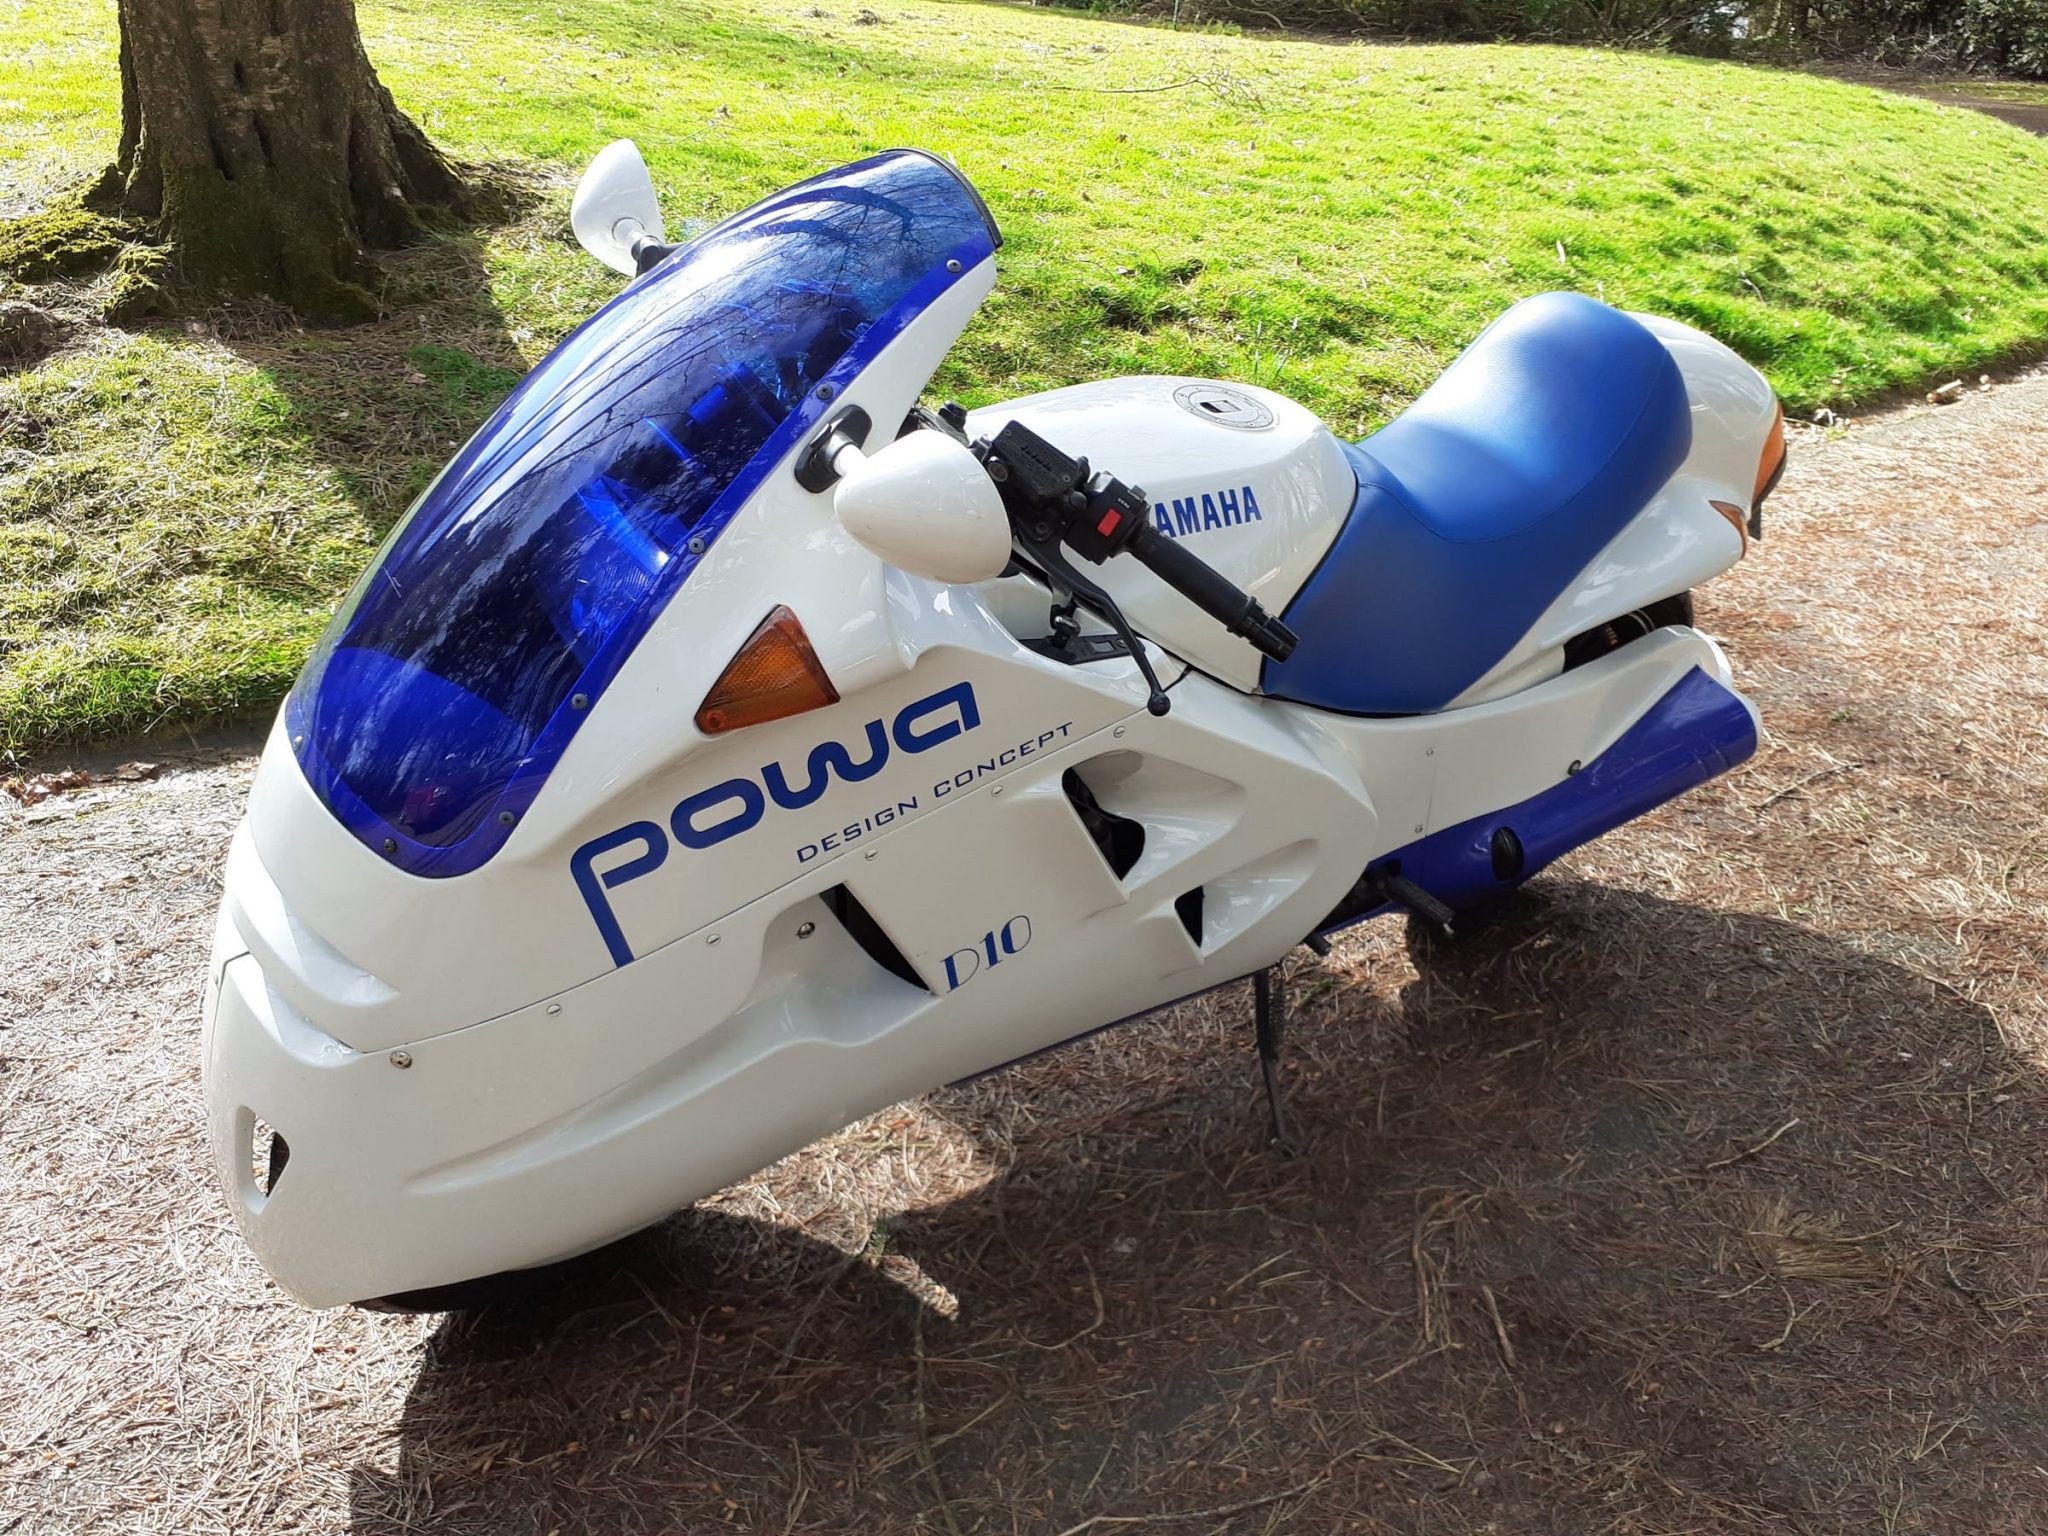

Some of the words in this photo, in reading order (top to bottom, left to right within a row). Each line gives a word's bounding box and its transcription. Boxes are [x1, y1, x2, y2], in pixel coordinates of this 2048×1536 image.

[1154, 486, 1262, 539] AMAHA
[797, 796, 919, 864] DESIGN
[933, 721, 1073, 799] CONCEPT
[939, 914, 1032, 994] D10
